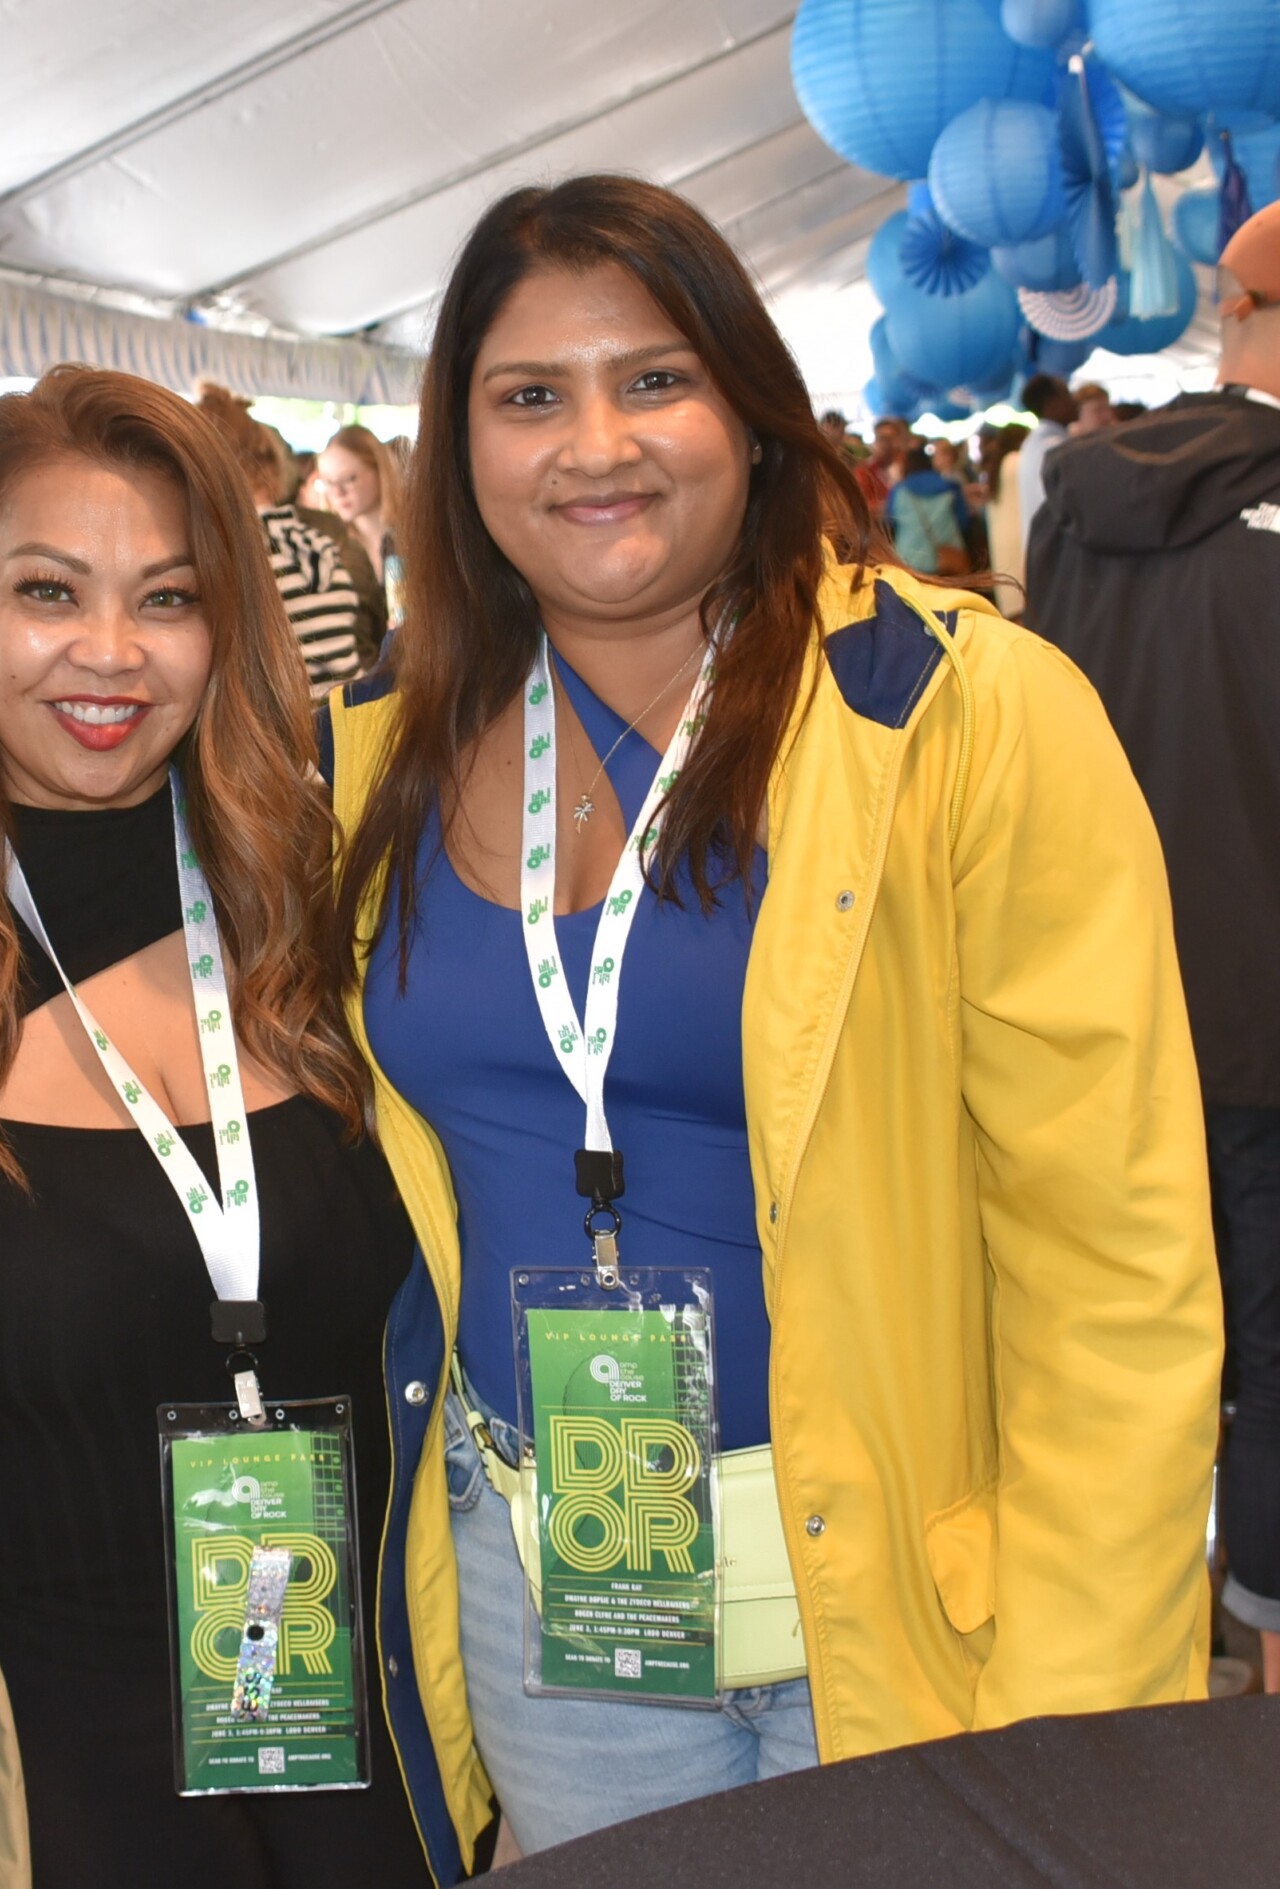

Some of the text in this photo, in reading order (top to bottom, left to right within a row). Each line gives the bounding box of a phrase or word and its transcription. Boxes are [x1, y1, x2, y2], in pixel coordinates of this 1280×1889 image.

[545, 1332, 687, 1343] VIP LOUNGE PASS
[190, 1453, 326, 1468] VIP LOUNGE PASS
